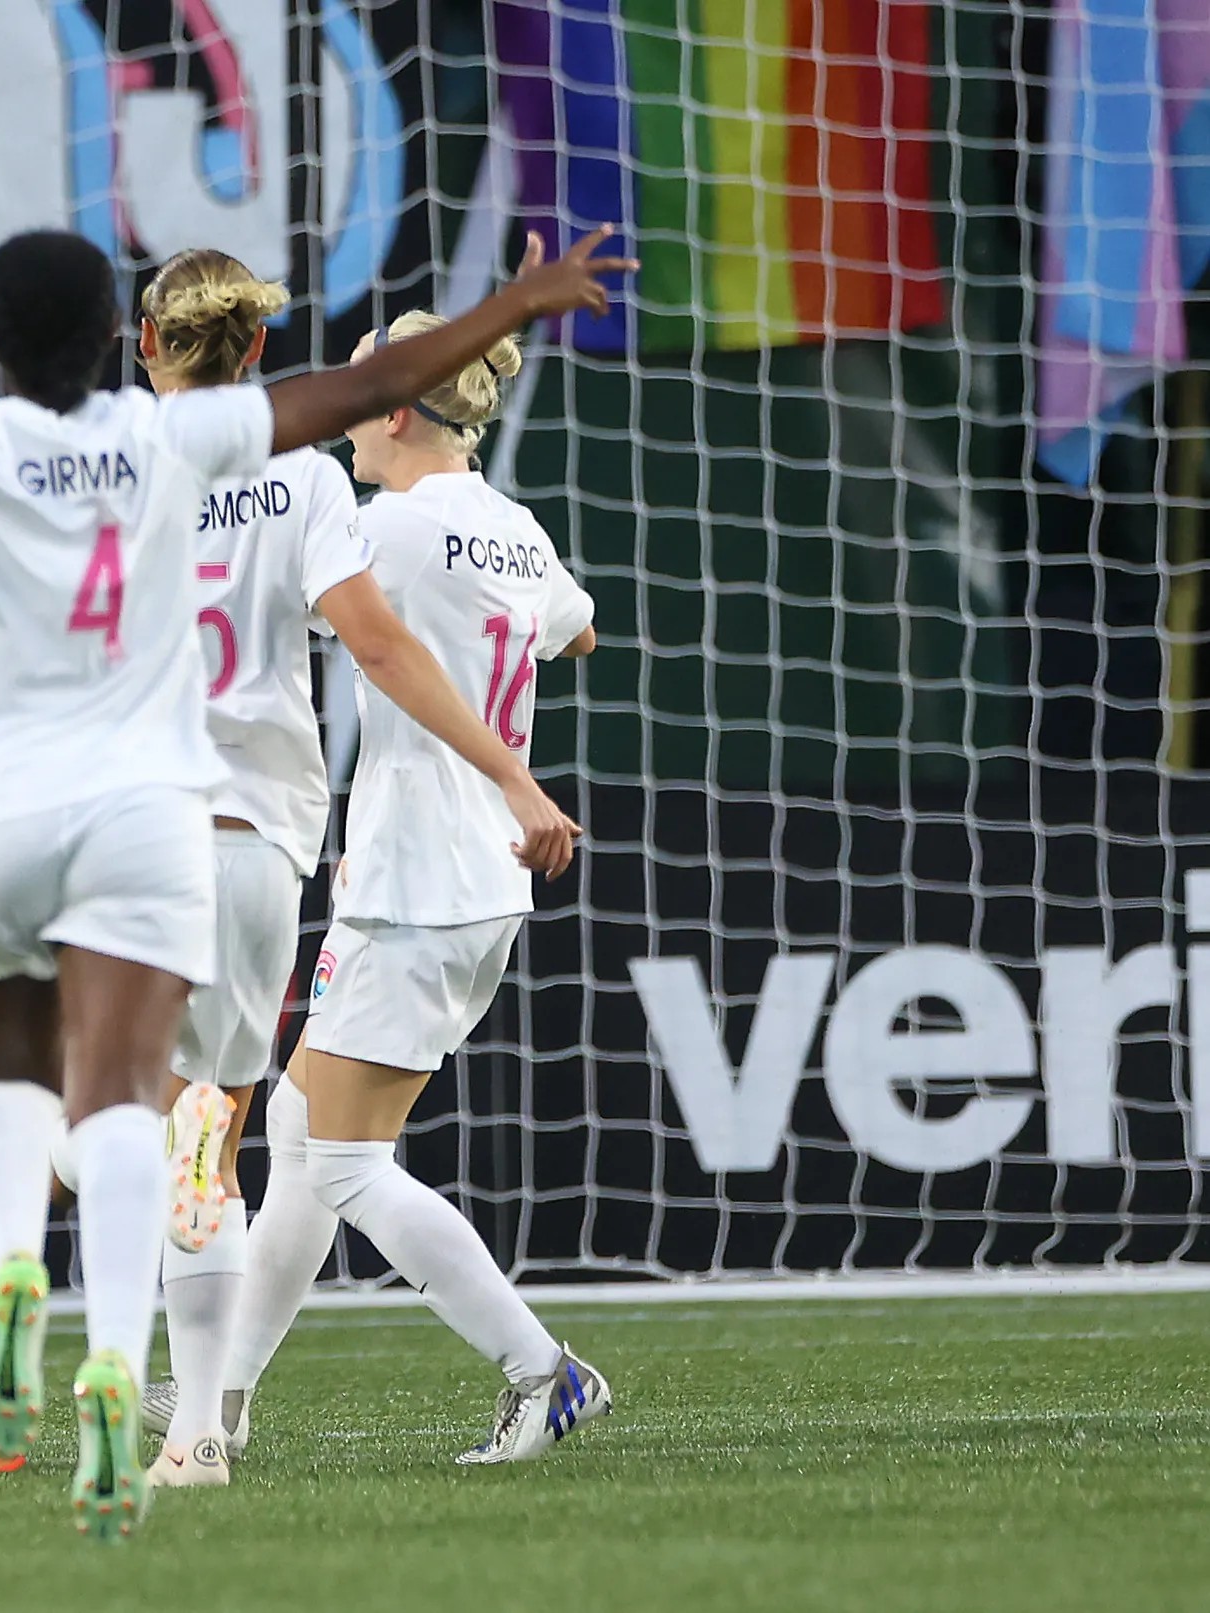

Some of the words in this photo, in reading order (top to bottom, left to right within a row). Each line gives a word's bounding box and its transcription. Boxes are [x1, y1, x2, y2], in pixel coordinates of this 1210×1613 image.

[17, 451, 138, 496] GIRMA
[445, 534, 547, 580] POGARC
[67, 522, 125, 666] 4
